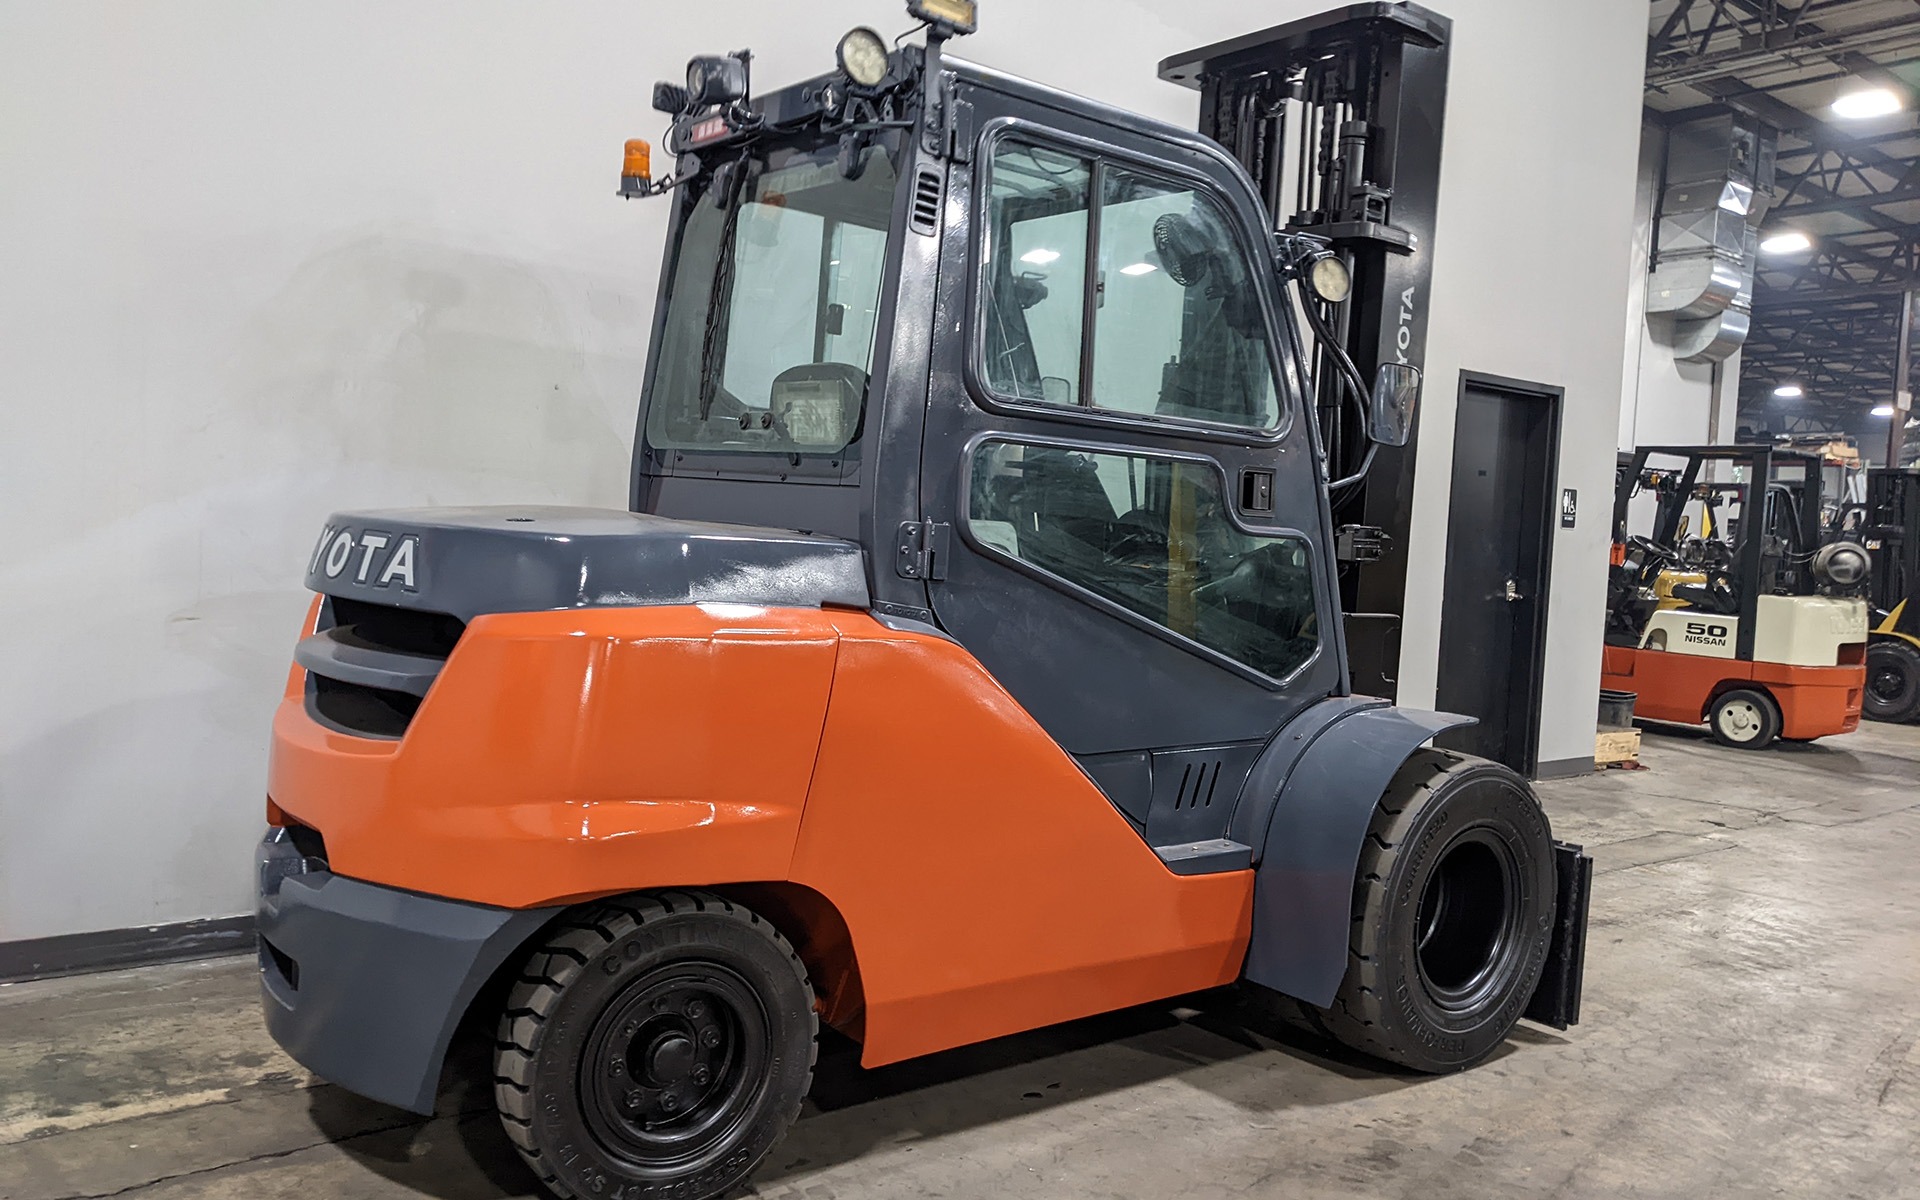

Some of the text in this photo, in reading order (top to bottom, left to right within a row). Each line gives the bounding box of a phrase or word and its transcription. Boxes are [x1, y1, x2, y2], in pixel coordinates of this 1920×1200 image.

[1866, 540, 1881, 549] CAT
[1686, 622, 1727, 637] 50
[1685, 634, 1726, 646] NISSAN
